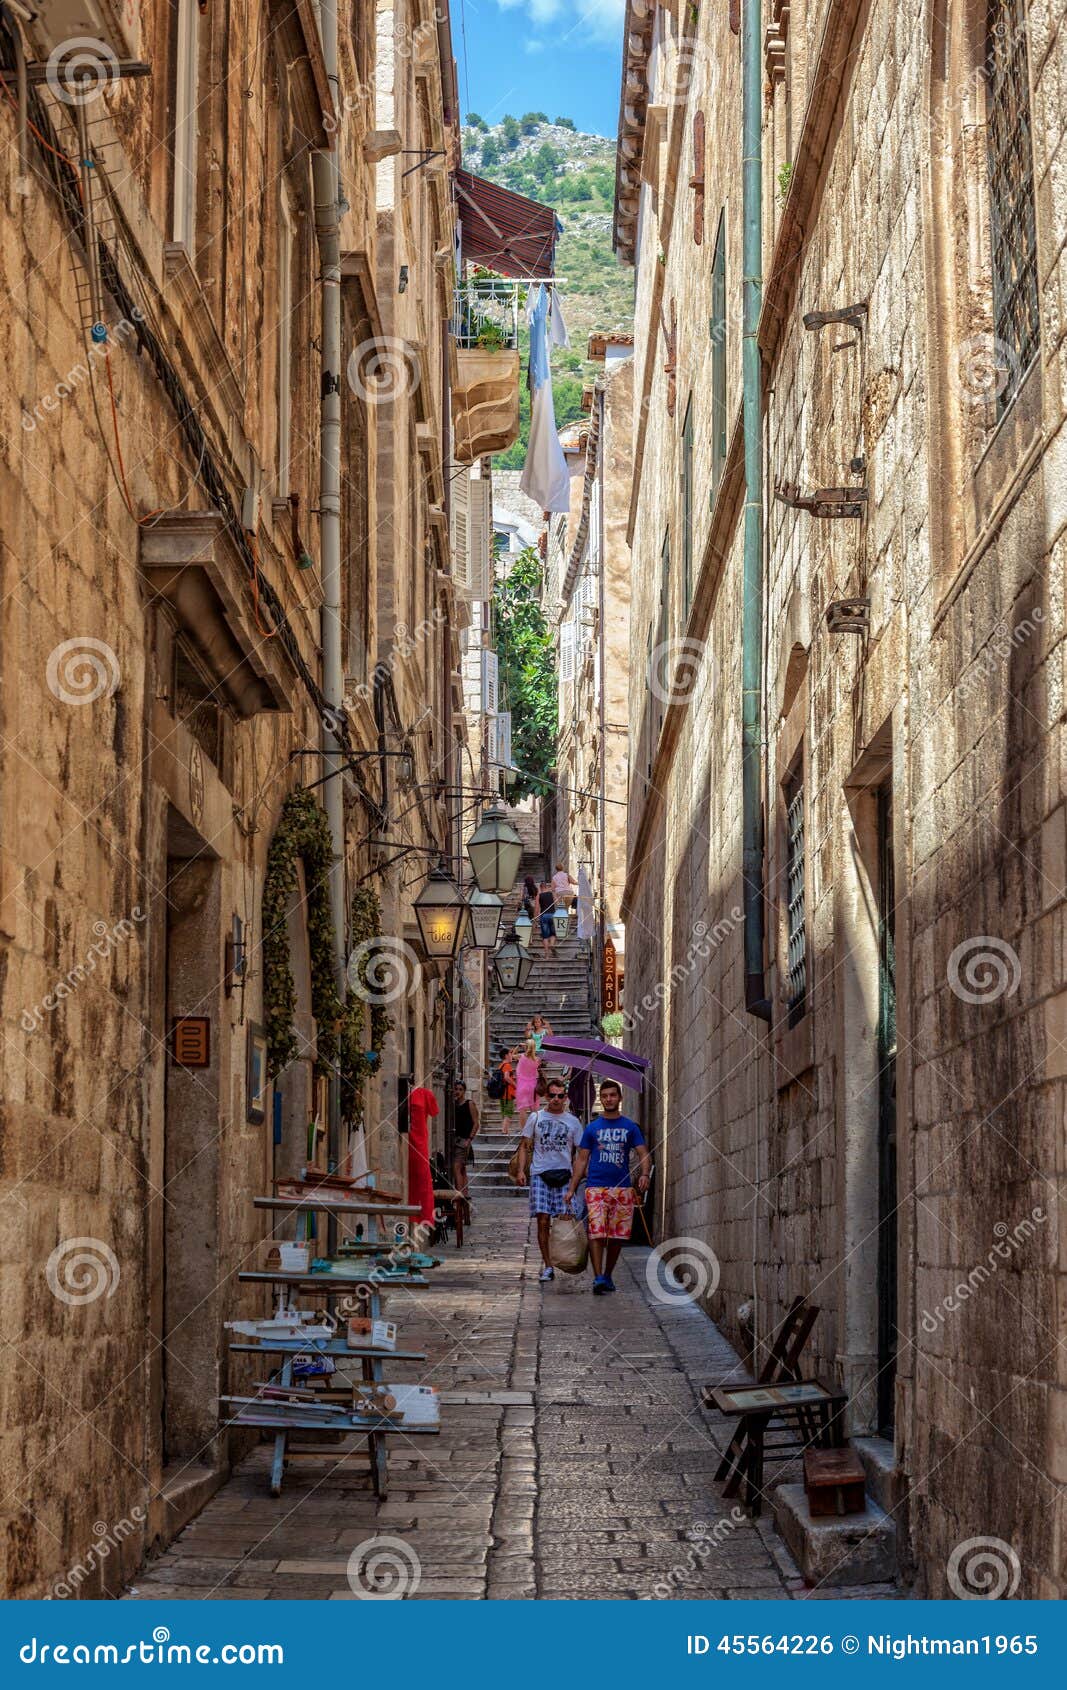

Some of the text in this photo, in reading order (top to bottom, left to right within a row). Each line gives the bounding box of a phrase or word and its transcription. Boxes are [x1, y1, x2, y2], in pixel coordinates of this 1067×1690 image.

[556, 918, 567, 929] R
[605, 947, 614, 1009] ROZARIO
[597, 1128, 629, 1143] JACK
[605, 1143, 620, 1151] AND
[598, 1152, 625, 1164] JONES
